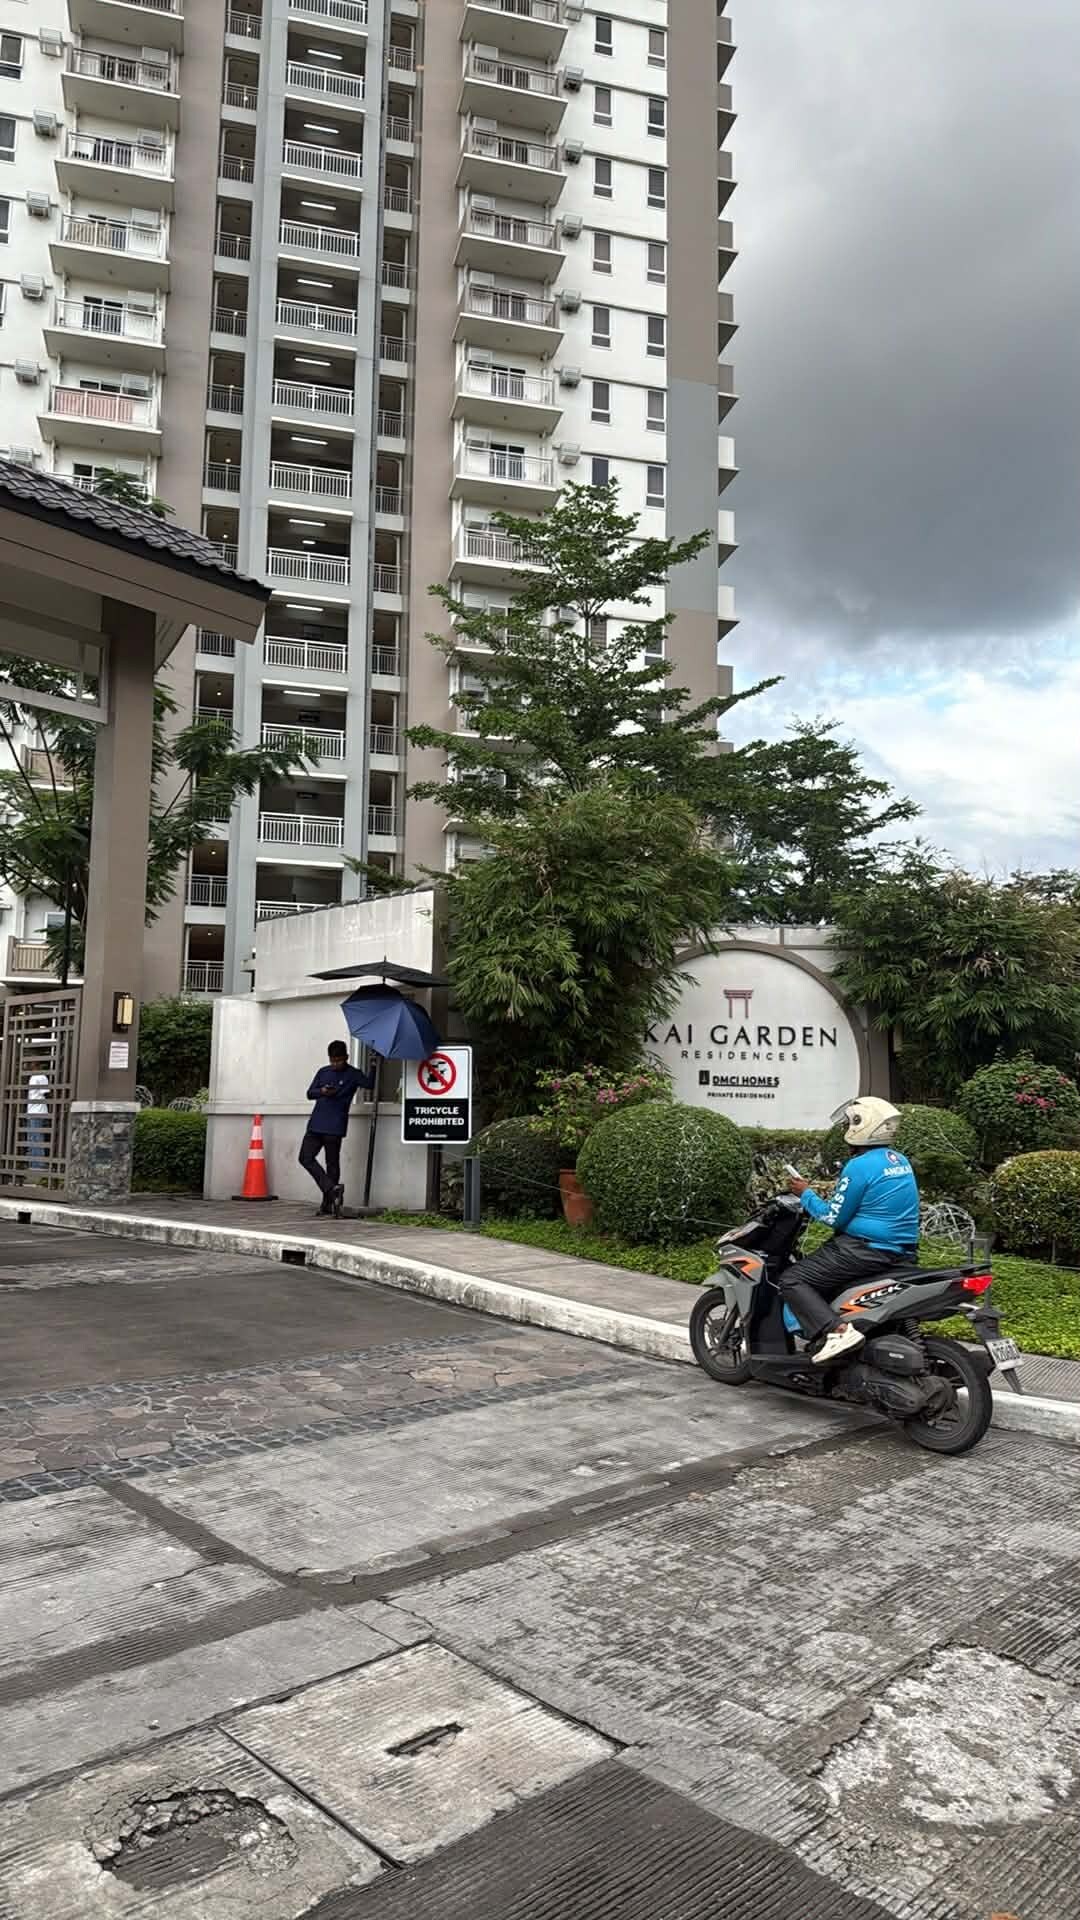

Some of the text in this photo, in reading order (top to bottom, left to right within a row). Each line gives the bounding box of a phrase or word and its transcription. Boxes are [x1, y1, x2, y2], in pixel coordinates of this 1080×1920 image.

[643, 1023, 837, 1047] KAI GARDEN
[681, 1050, 799, 1061] RESIDENCES
[712, 1075, 780, 1088] DMCI HOMES
[414, 1106, 460, 1115] TRICYCLE
[408, 1117, 465, 1126] PROHIBITED
[848, 1283, 902, 1306] CLICK
